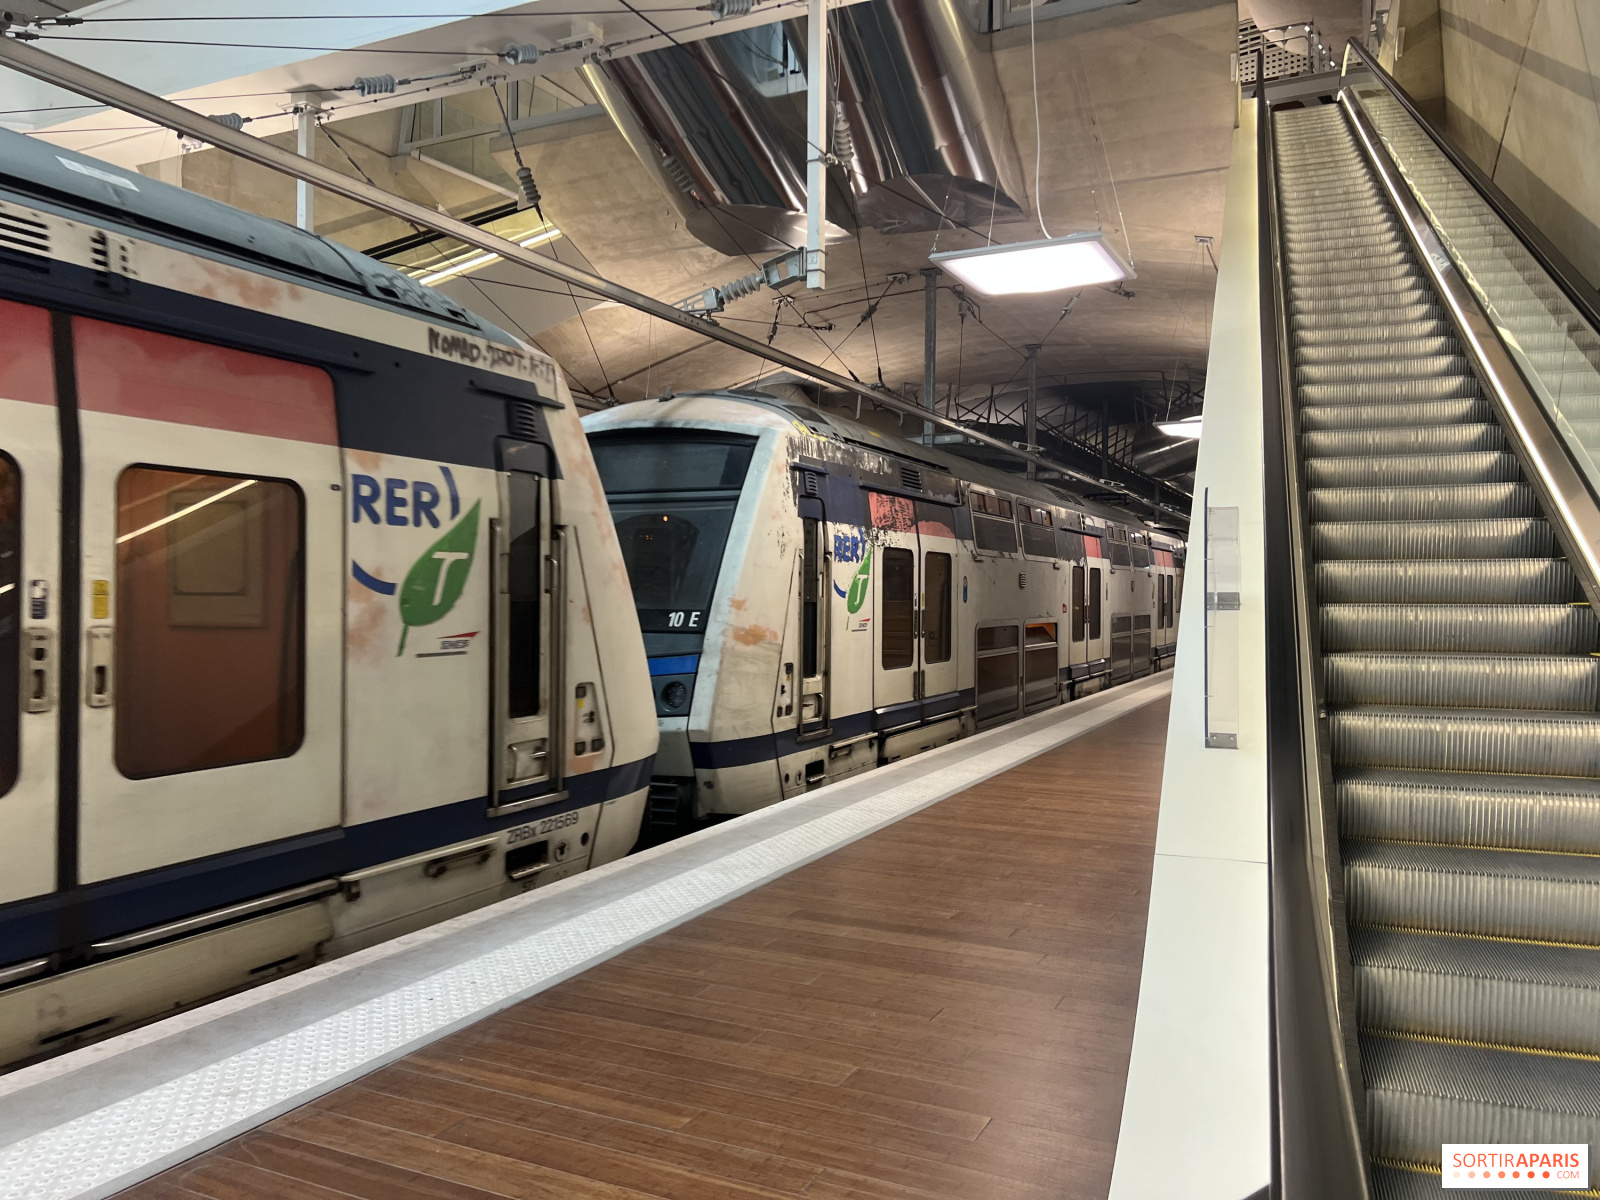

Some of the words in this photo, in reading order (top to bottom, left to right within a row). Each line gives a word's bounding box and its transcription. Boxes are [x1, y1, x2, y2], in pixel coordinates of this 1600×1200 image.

[352, 473, 441, 529] RER
[833, 534, 860, 564] RER
[432, 551, 470, 606] T
[668, 611, 685, 628] 10
[688, 611, 701, 628] E
[540, 811, 579, 835] 221569
